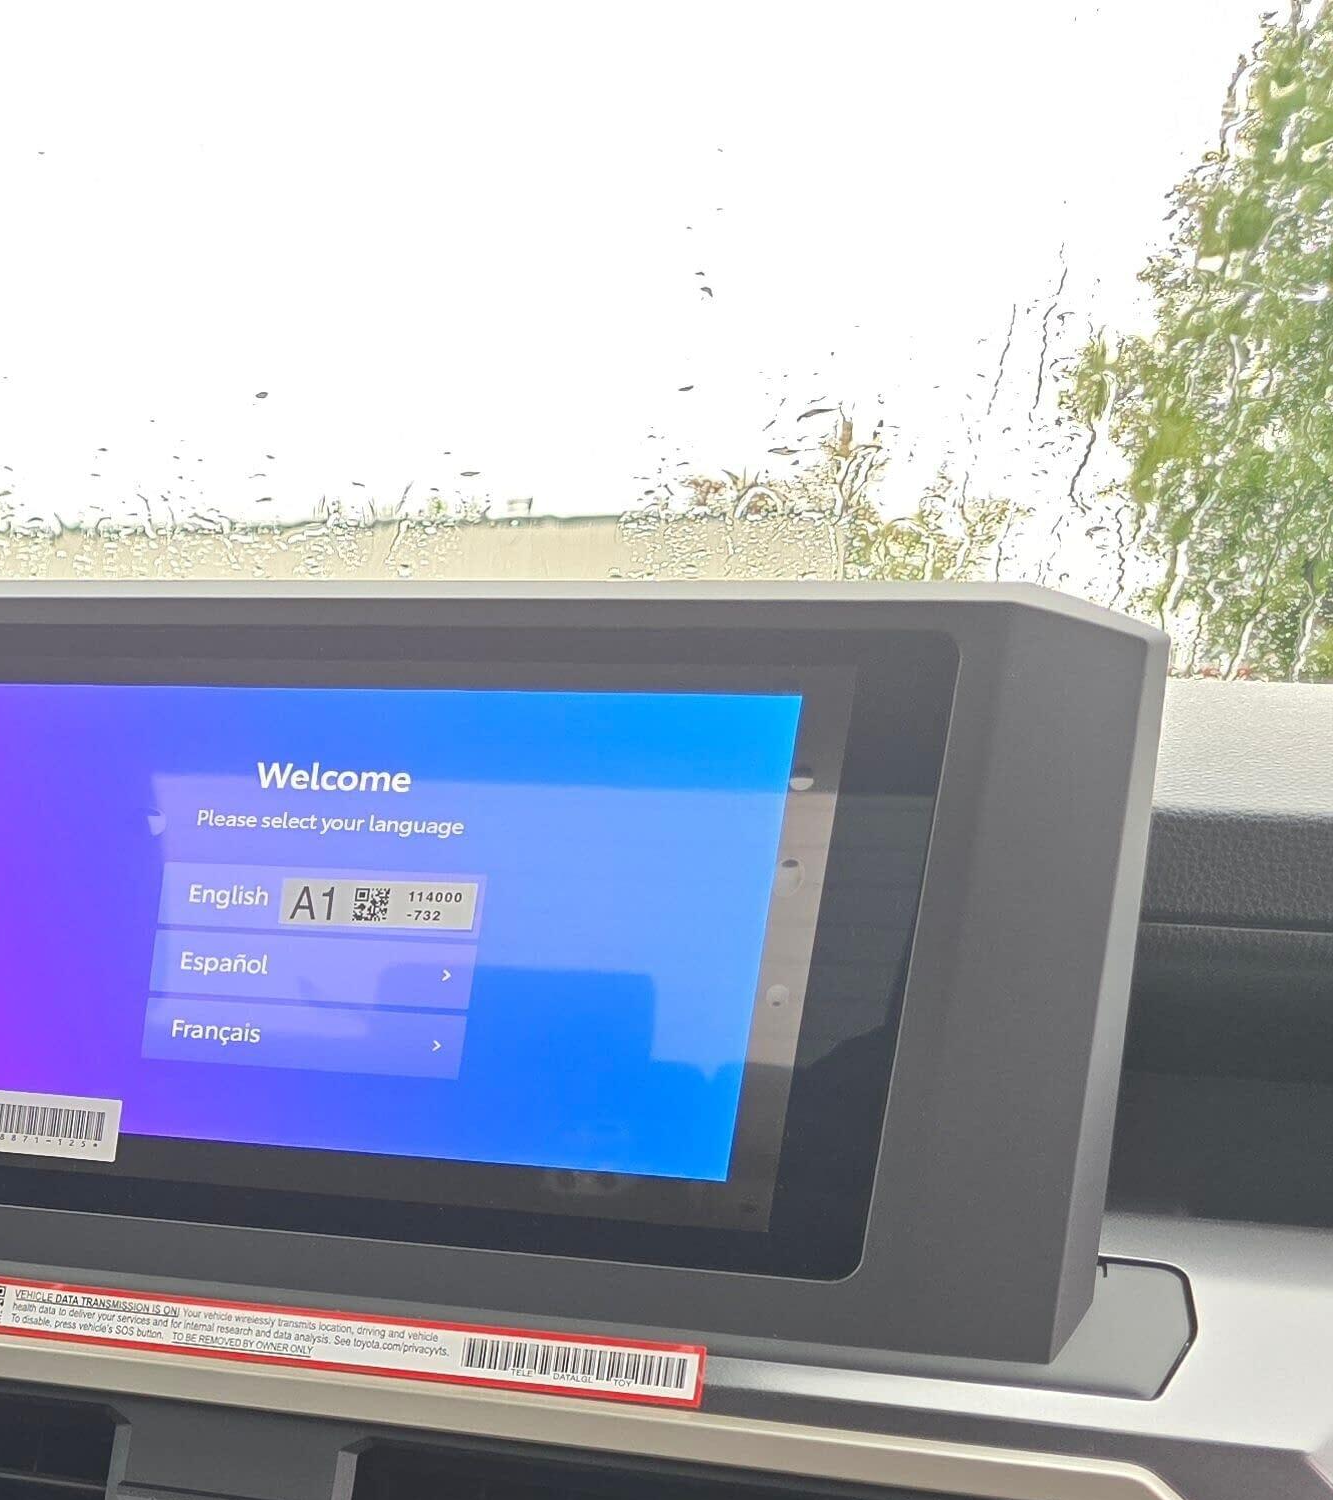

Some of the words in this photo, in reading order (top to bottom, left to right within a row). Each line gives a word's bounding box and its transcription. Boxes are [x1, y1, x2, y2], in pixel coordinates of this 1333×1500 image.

[257, 761, 411, 792] Welcome
[197, 810, 257, 828] Please
[262, 812, 317, 830] select
[321, 818, 364, 834] your
[369, 815, 464, 839] language
[189, 884, 269, 907] English
[290, 885, 336, 921] A1
[408, 891, 462, 903] 114000
[406, 909, 441, 921] -732
[180, 951, 268, 976] Español
[171, 1019, 261, 1045] Français
[11, 1302, 37, 1313] health
[38, 1304, 56, 1315] data
[57, 1307, 66, 1315] to
[68, 1308, 96, 1319] deliver
[97, 1311, 114, 1322] your
[116, 1315, 150, 1326] services
[152, 1318, 167, 1327] and
[170, 1319, 181, 1328] for
[216, 1325, 253, 1336] research
[254, 1328, 271, 1338] and
[272, 1330, 292, 1340] data
[293, 1332, 331, 1345] analysis.
[333, 1336, 351, 1346] See
[14, 1289, 53, 1302] VEHICLE
[54, 1293, 79, 1305] DATA
[81, 1297, 150, 1313] TRANSMISSION
[151, 1305, 160, 1314] IS
[182, 1309, 202, 1319] Your
[202, 1312, 233, 1322] vehicle
[234, 1314, 276, 1327] wirelessly
[277, 1318, 316, 1330] transmits
[318, 1322, 354, 1335] location,
[356, 1325, 386, 1338] driving
[387, 1329, 405, 1339] and
[407, 1331, 438, 1342] vehicle
[10, 1313, 21, 1323] To
[54, 1318, 76, 1329] press
[114, 1326, 134, 1337] SOS
[172, 1332, 184, 1341] TO
[185, 1333, 197, 1343] BE
[197, 1335, 241, 1348] REMOVED
[241, 1339, 254, 1348] BY
[255, 1341, 289, 1352] OWNER
[289, 1344, 313, 1355] ONLY
[511, 1368, 533, 1377] TELE
[613, 1378, 633, 1388] TOY
